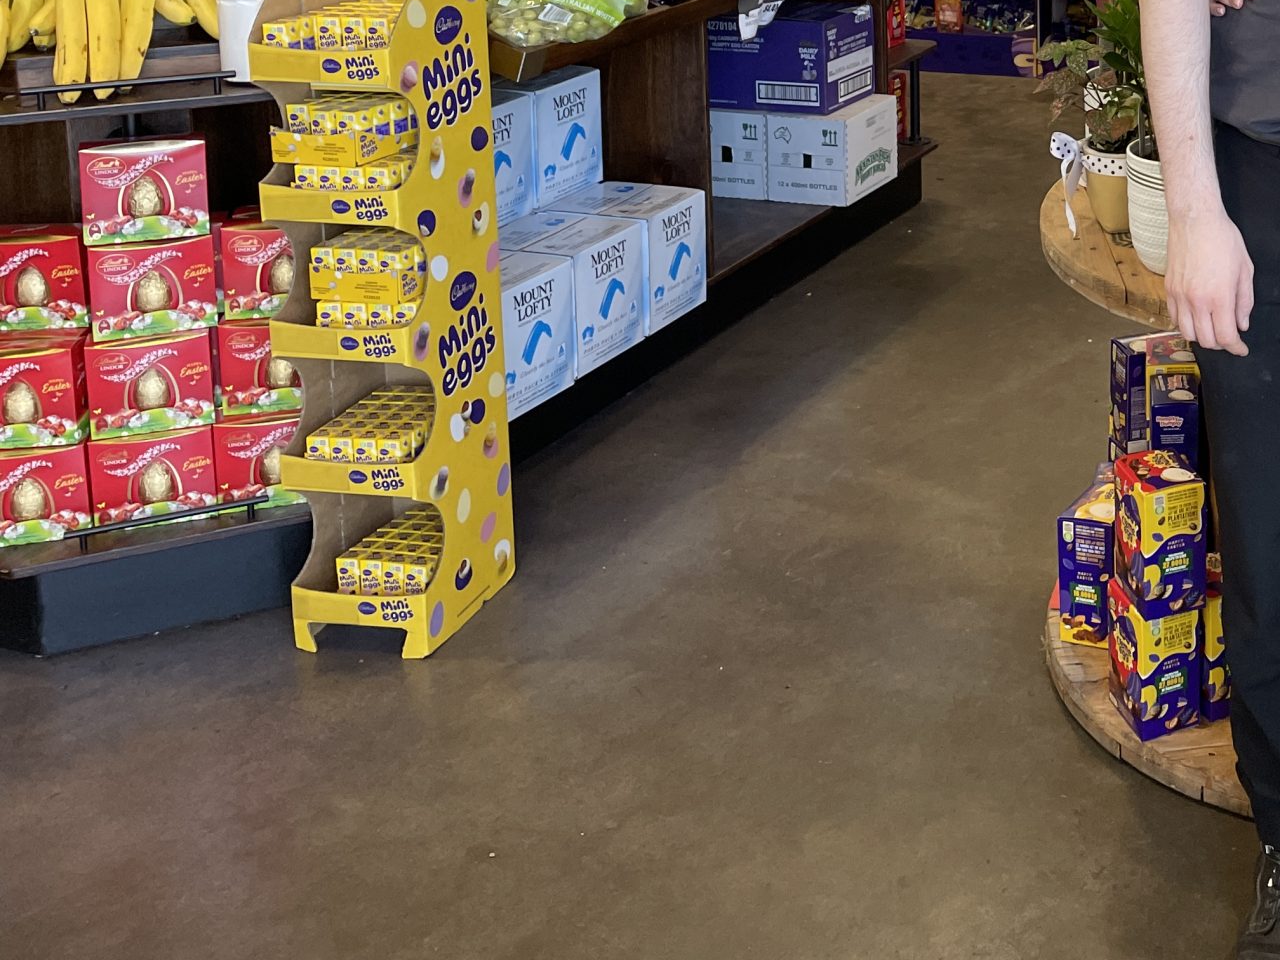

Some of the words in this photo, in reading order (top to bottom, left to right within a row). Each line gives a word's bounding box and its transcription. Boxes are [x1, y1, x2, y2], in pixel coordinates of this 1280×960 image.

[436, 16, 460, 34] Cadbury
[320, 34, 336, 42] Mini
[320, 40, 338, 48] eggs
[345, 54, 375, 70] Mini
[422, 32, 474, 100] Mini
[348, 66, 380, 80] eggs
[426, 68, 482, 130] eggs
[552, 88, 588, 110] MOUNT
[557, 100, 586, 121] LOFTY
[492, 113, 514, 131] UNT
[494, 127, 512, 144] FTY
[175, 172, 204, 186] Easter
[728, 176, 755, 184] BOTTLES
[809, 183, 838, 191] BOTTLES
[354, 196, 384, 210] Mini
[356, 206, 388, 221] eggs
[662, 206, 692, 232] MOUNT
[665, 218, 692, 242] LOFTY
[590, 240, 626, 268] MOUNT
[51, 267, 80, 279] Easter
[184, 265, 213, 280] Easter
[595, 253, 625, 280] LOFTY
[513, 279, 554, 310] MOUNT
[518, 294, 552, 322] LOFTY
[439, 292, 488, 369] Mini
[362, 333, 391, 347] Mini
[365, 345, 397, 358] eggs
[442, 326, 496, 396] eggs
[180, 364, 209, 378] Easter
[42, 382, 72, 394] Easter
[183, 458, 212, 471] Easter
[371, 466, 400, 480] Mini
[54, 477, 84, 490] Easter
[374, 477, 404, 491] eggs
[340, 574, 355, 582] Mini
[340, 580, 358, 588] eggs
[380, 598, 410, 612] Mini
[383, 608, 414, 622] eggs
